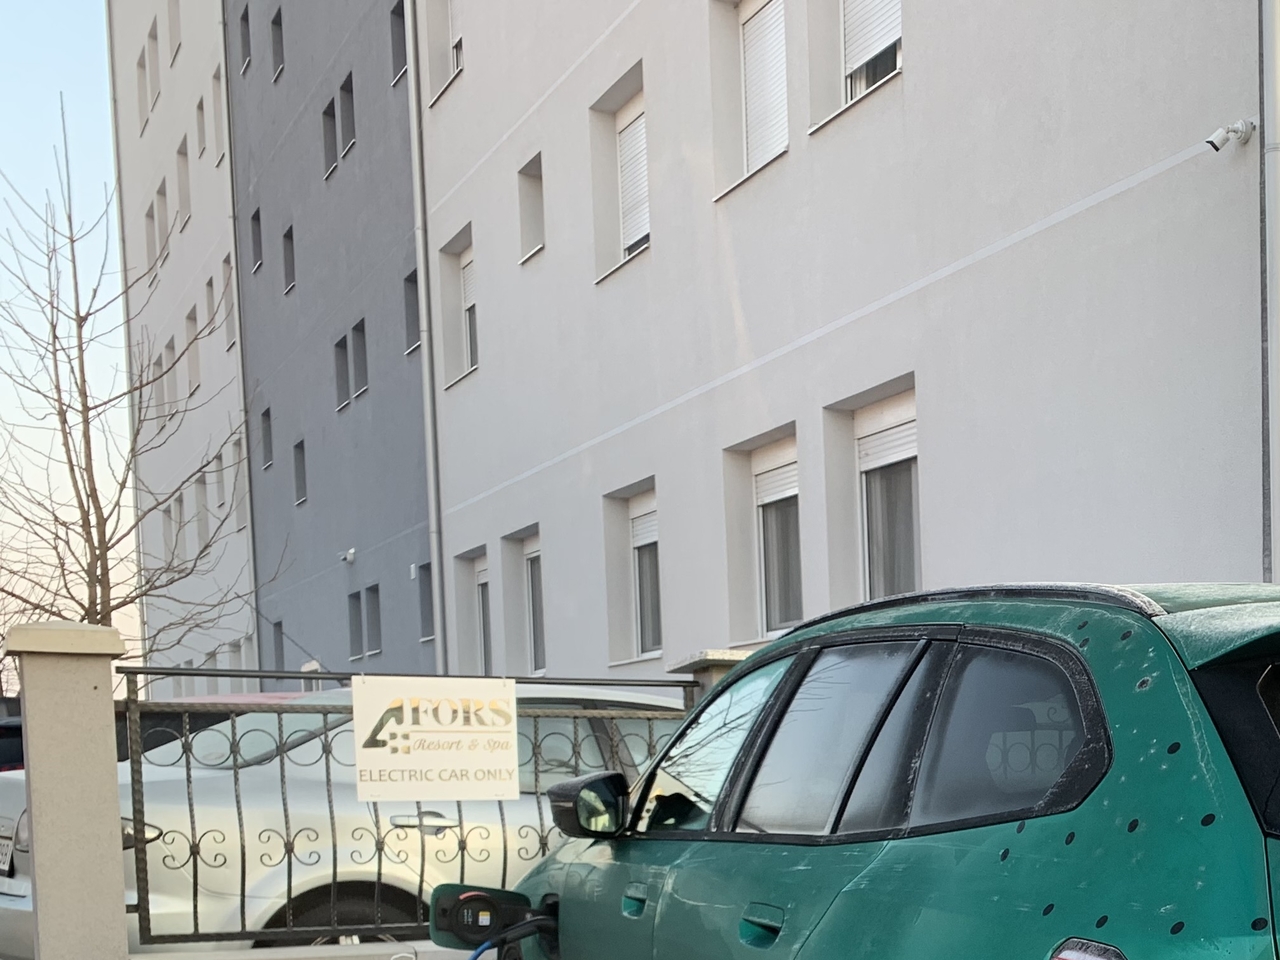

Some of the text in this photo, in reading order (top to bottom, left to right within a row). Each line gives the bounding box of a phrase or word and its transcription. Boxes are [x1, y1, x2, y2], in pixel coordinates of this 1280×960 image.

[413, 737, 464, 751] Resort
[483, 737, 513, 753] Spa
[359, 768, 515, 782] ELECTRIC CAR ONLY
